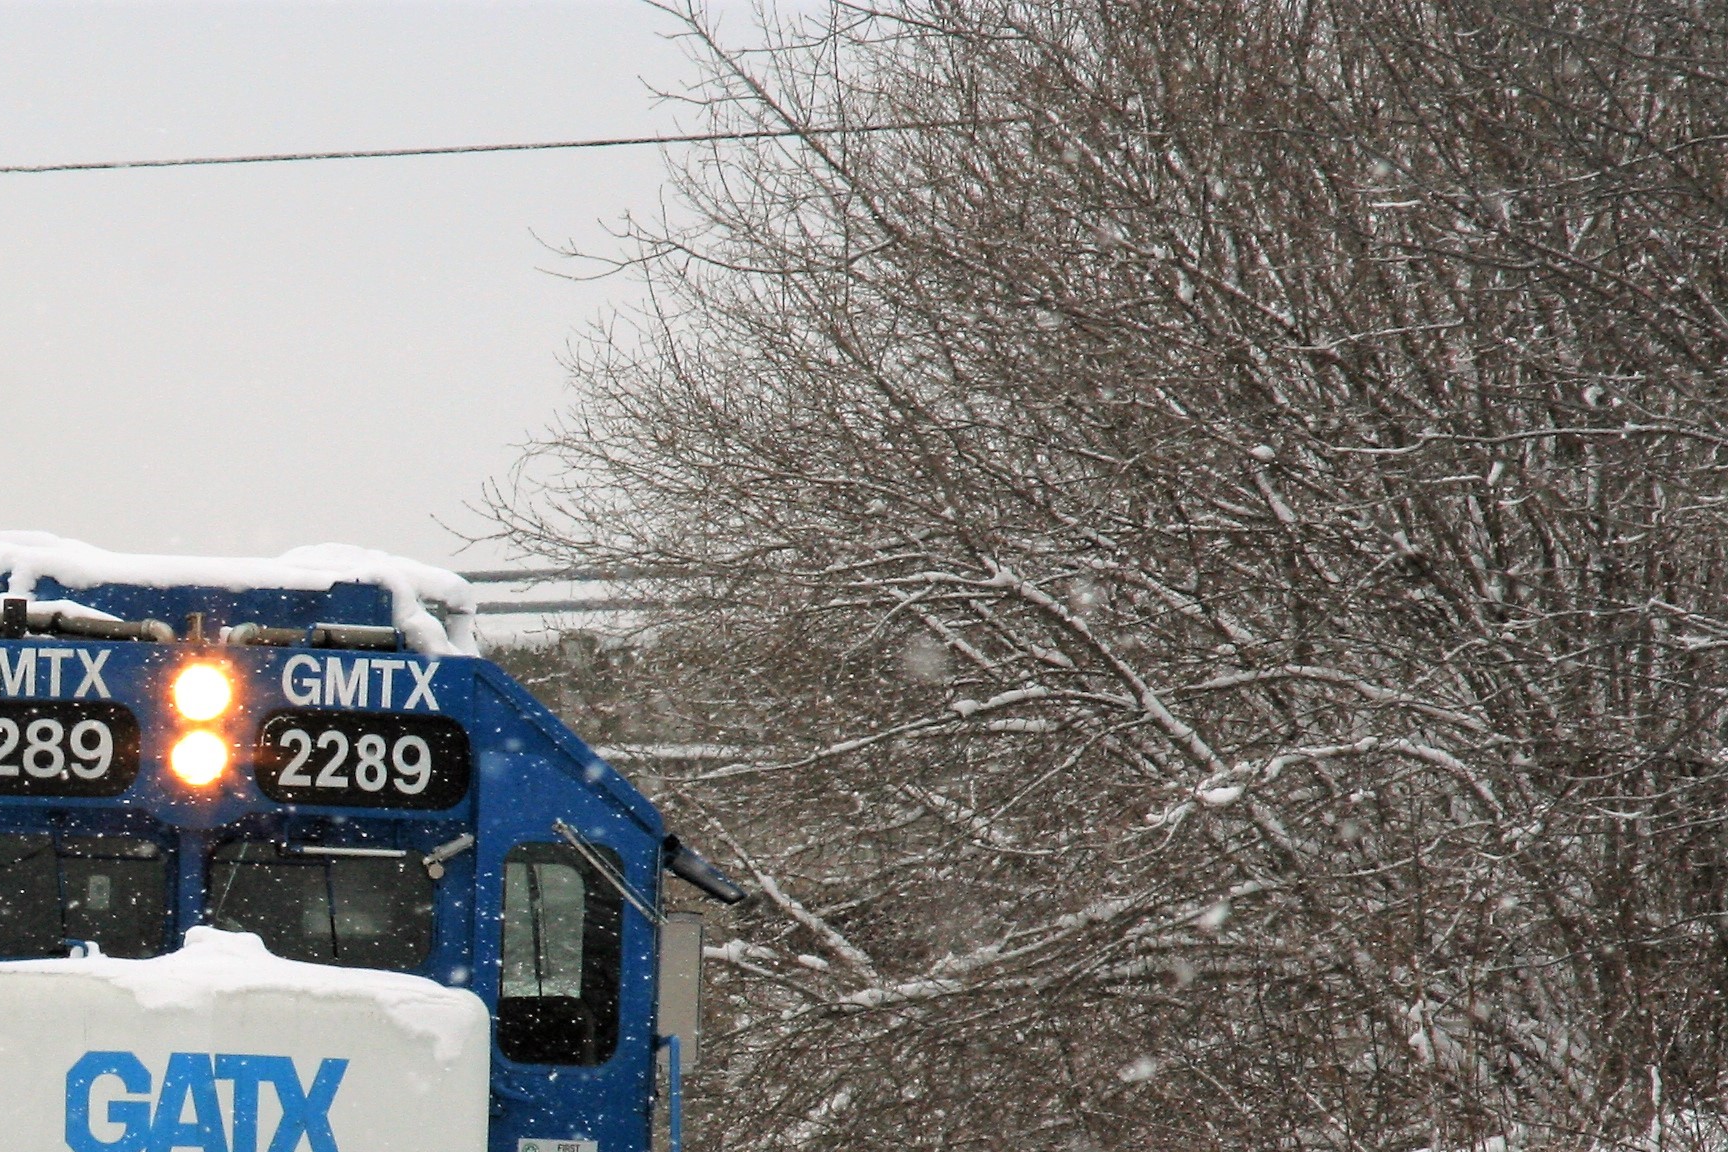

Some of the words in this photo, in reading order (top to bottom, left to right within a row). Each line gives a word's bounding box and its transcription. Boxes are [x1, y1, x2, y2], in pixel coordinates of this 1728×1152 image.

[282, 654, 440, 711] GMTX
[278, 728, 432, 795] 2289
[557, 1143, 580, 1152] FIRST
